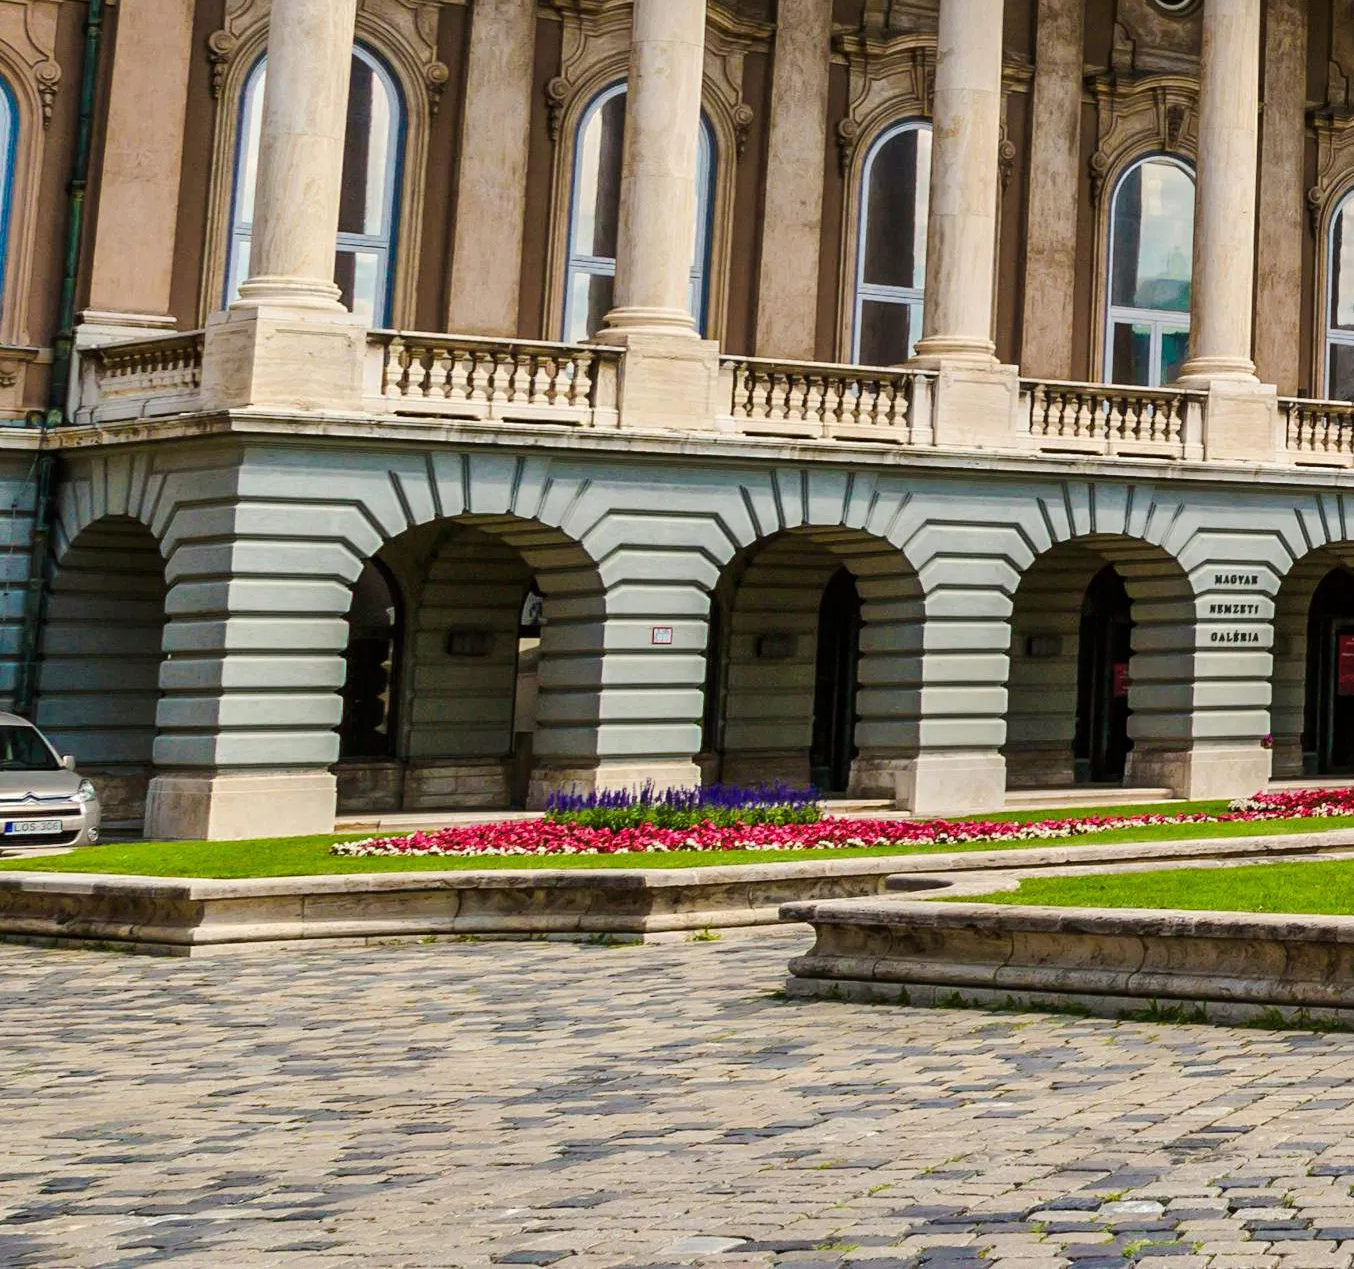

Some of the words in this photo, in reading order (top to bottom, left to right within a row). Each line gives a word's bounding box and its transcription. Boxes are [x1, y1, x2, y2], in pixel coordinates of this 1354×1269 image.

[1214, 574, 1258, 585] MAGYAR
[1209, 604, 1259, 614] NEMZETI
[1210, 630, 1259, 642] GALÉRIA
